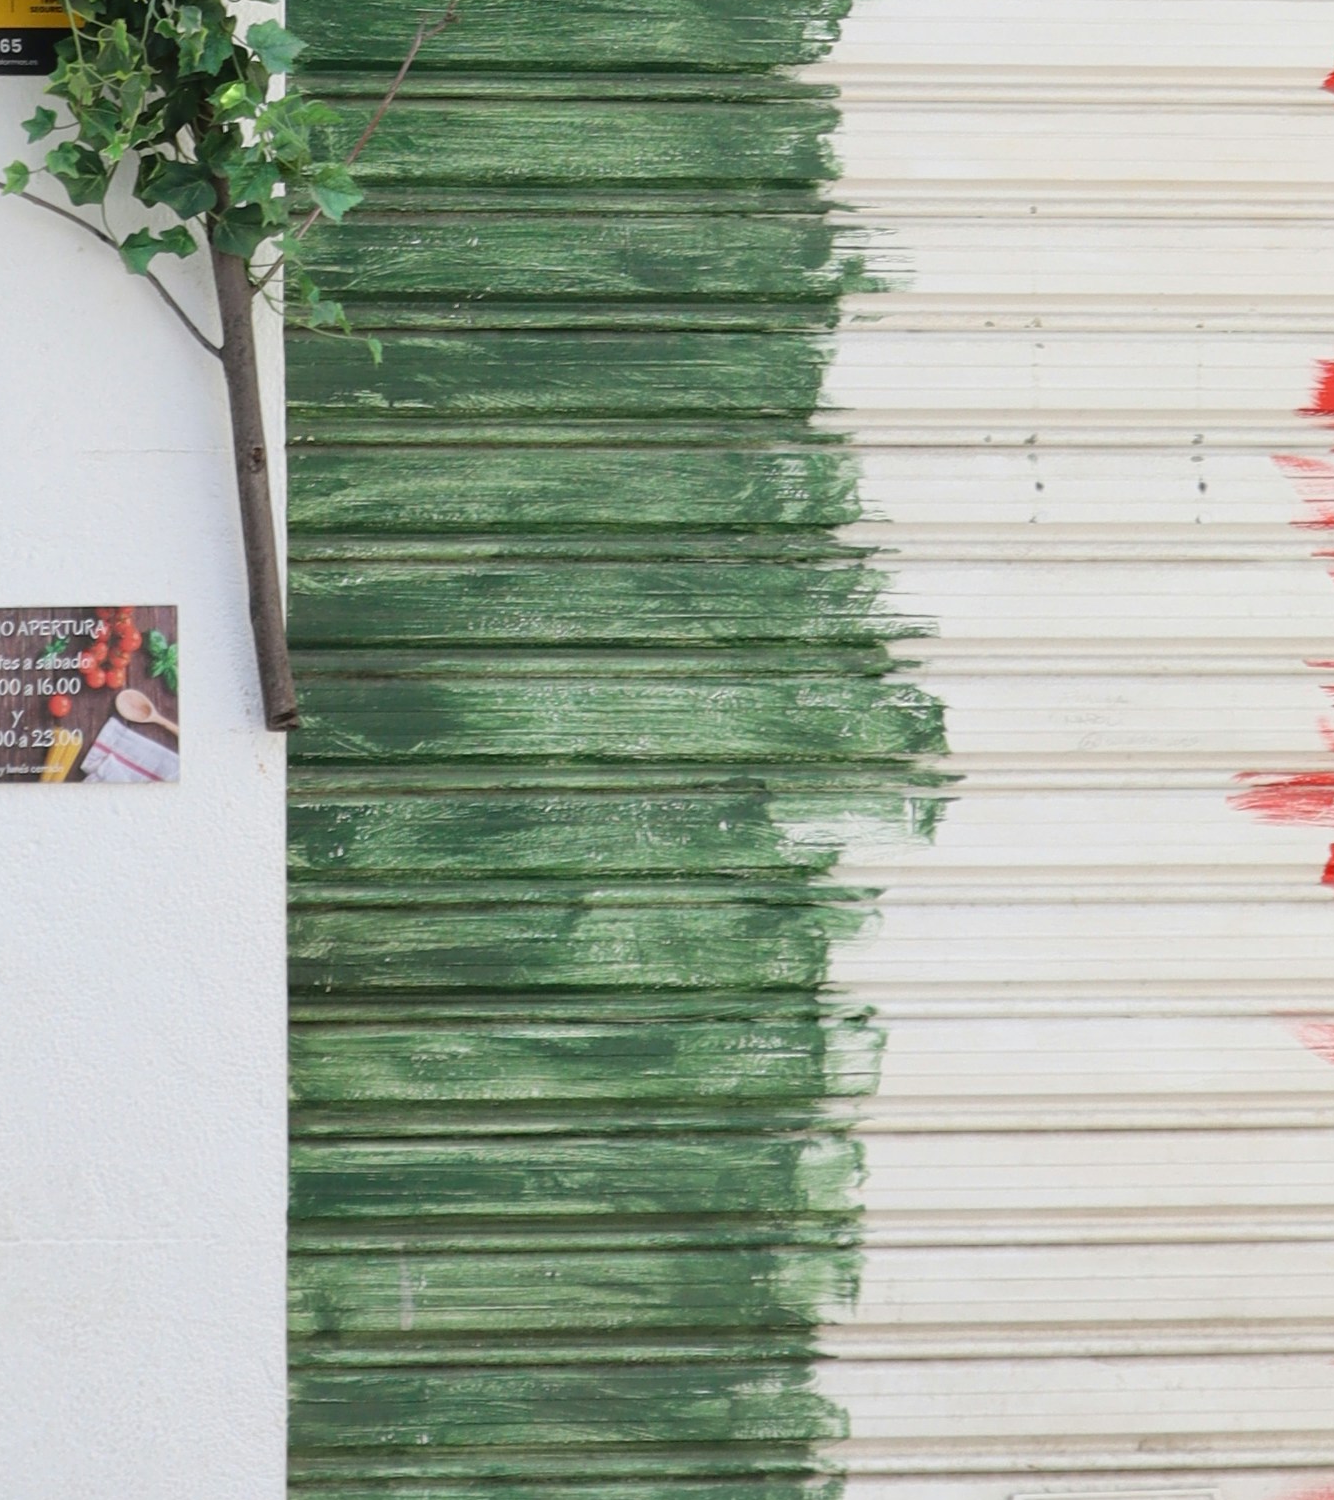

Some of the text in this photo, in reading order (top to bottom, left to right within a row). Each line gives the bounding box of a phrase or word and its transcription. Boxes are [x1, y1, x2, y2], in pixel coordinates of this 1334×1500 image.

[17, 619, 107, 640] APERTURA
[22, 658, 33, 671] a
[24, 684, 34, 697] a
[37, 677, 81, 696] 16.00
[31, 729, 83, 749] 23.00
